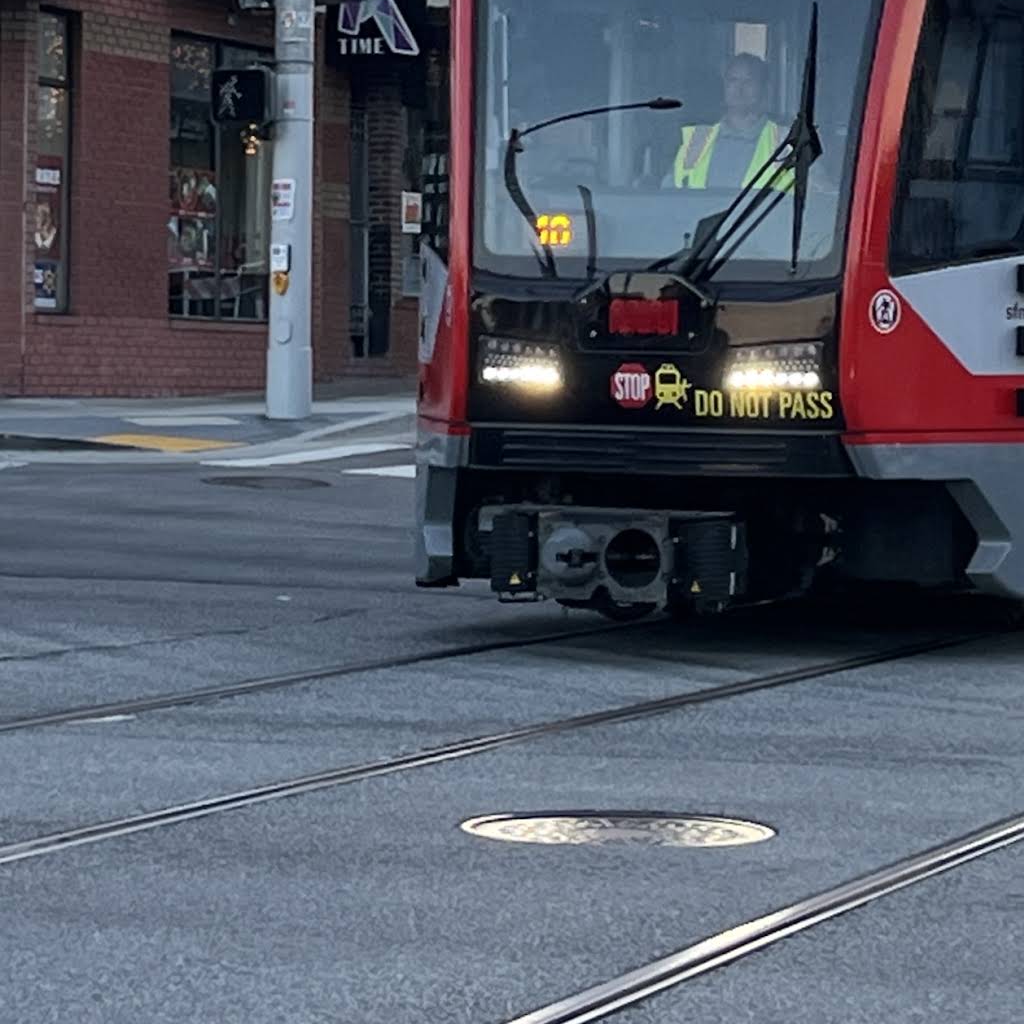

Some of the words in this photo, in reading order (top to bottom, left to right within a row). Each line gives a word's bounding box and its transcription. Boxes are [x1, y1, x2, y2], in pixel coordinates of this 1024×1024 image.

[338, 38, 384, 54] TIME
[614, 372, 651, 401] STOP
[694, 389, 723, 417] DO
[730, 390, 774, 418] NOT
[779, 391, 834, 419] PASS
